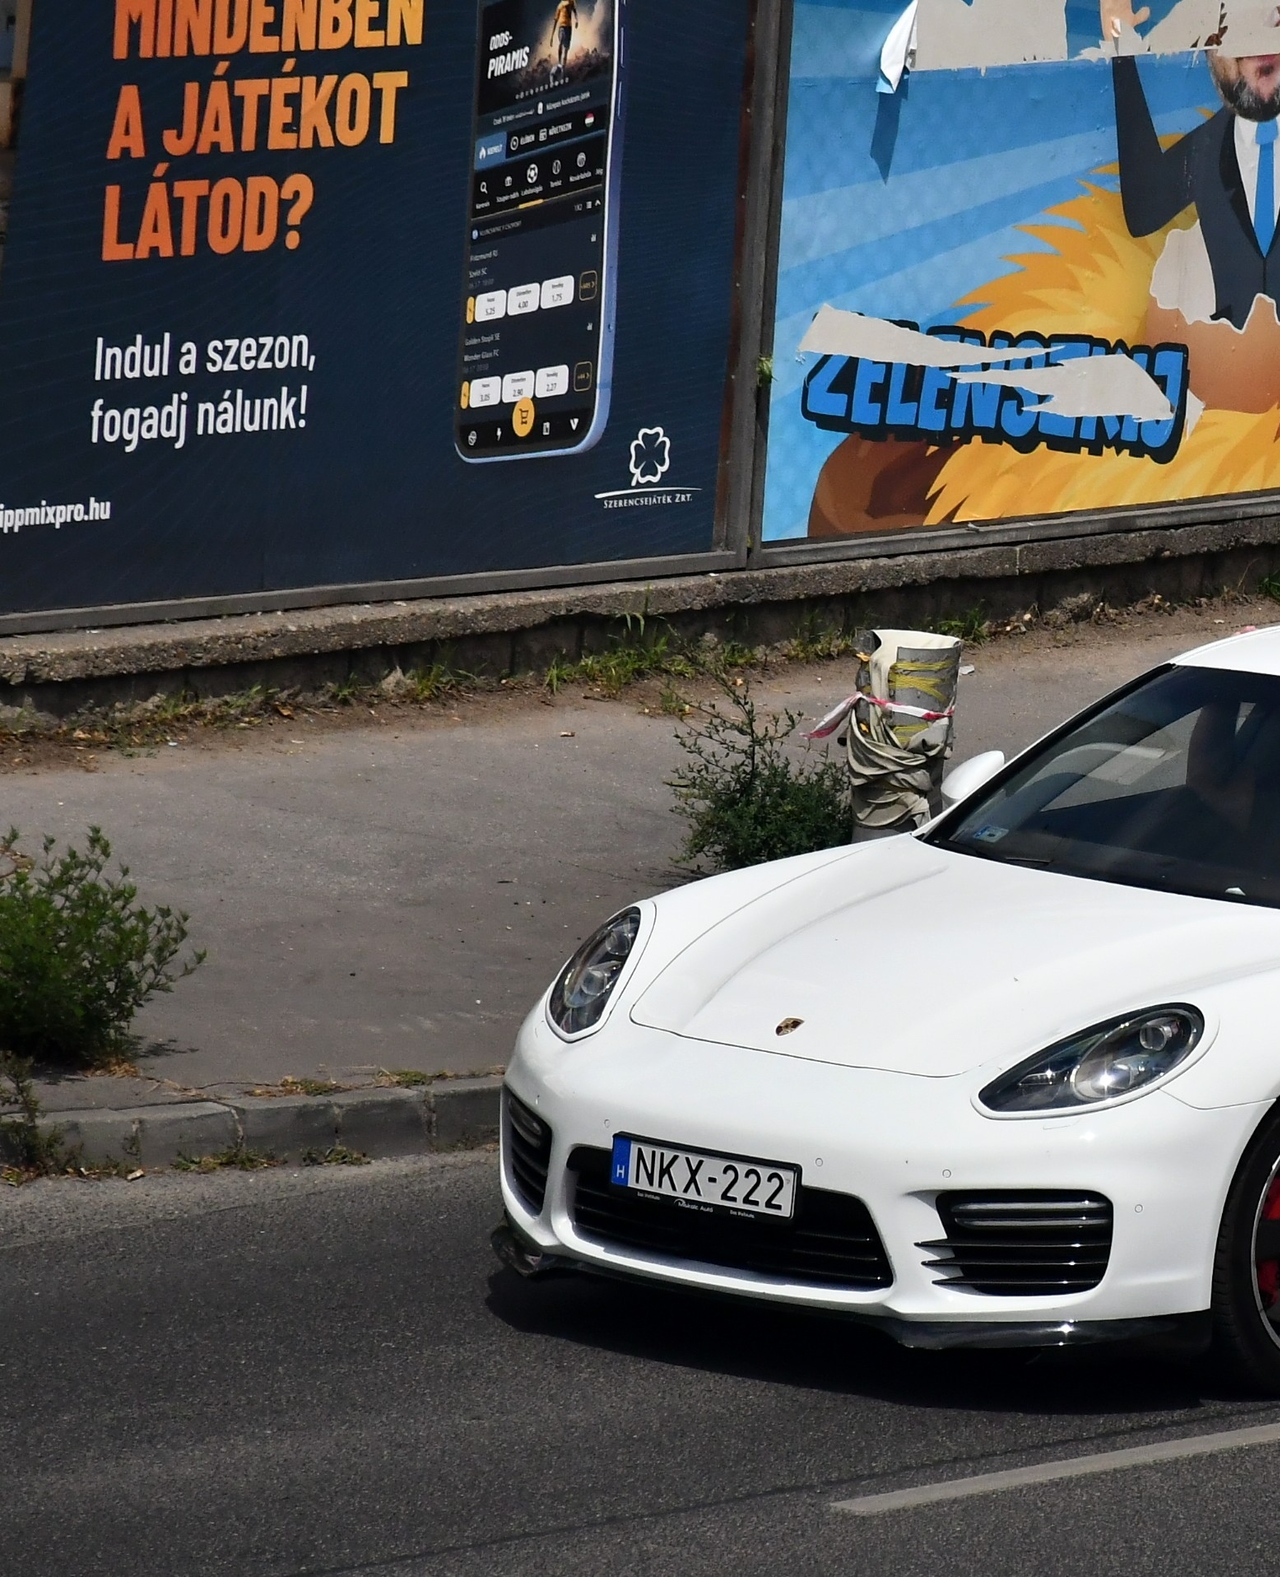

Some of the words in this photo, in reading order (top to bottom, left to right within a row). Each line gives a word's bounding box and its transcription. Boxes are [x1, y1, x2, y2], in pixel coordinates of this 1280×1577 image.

[113, 0, 425, 59] MINDENBEN
[487, 47, 530, 79] PIRAMIS
[106, 85, 145, 159] A
[162, 58, 408, 156] JÁTÉKOT
[102, 162, 314, 261] LÁTOD?
[94, 332, 171, 381] Indul
[178, 340, 197, 375] a
[205, 333, 316, 373] szezon,
[90, 392, 188, 453] fogadj
[197, 384, 308, 435] nálunk!
[0, 496, 111, 534] ippmixpro.hu
[616, 1164, 625, 1179] H
[634, 1146, 785, 1211] NKX-222
